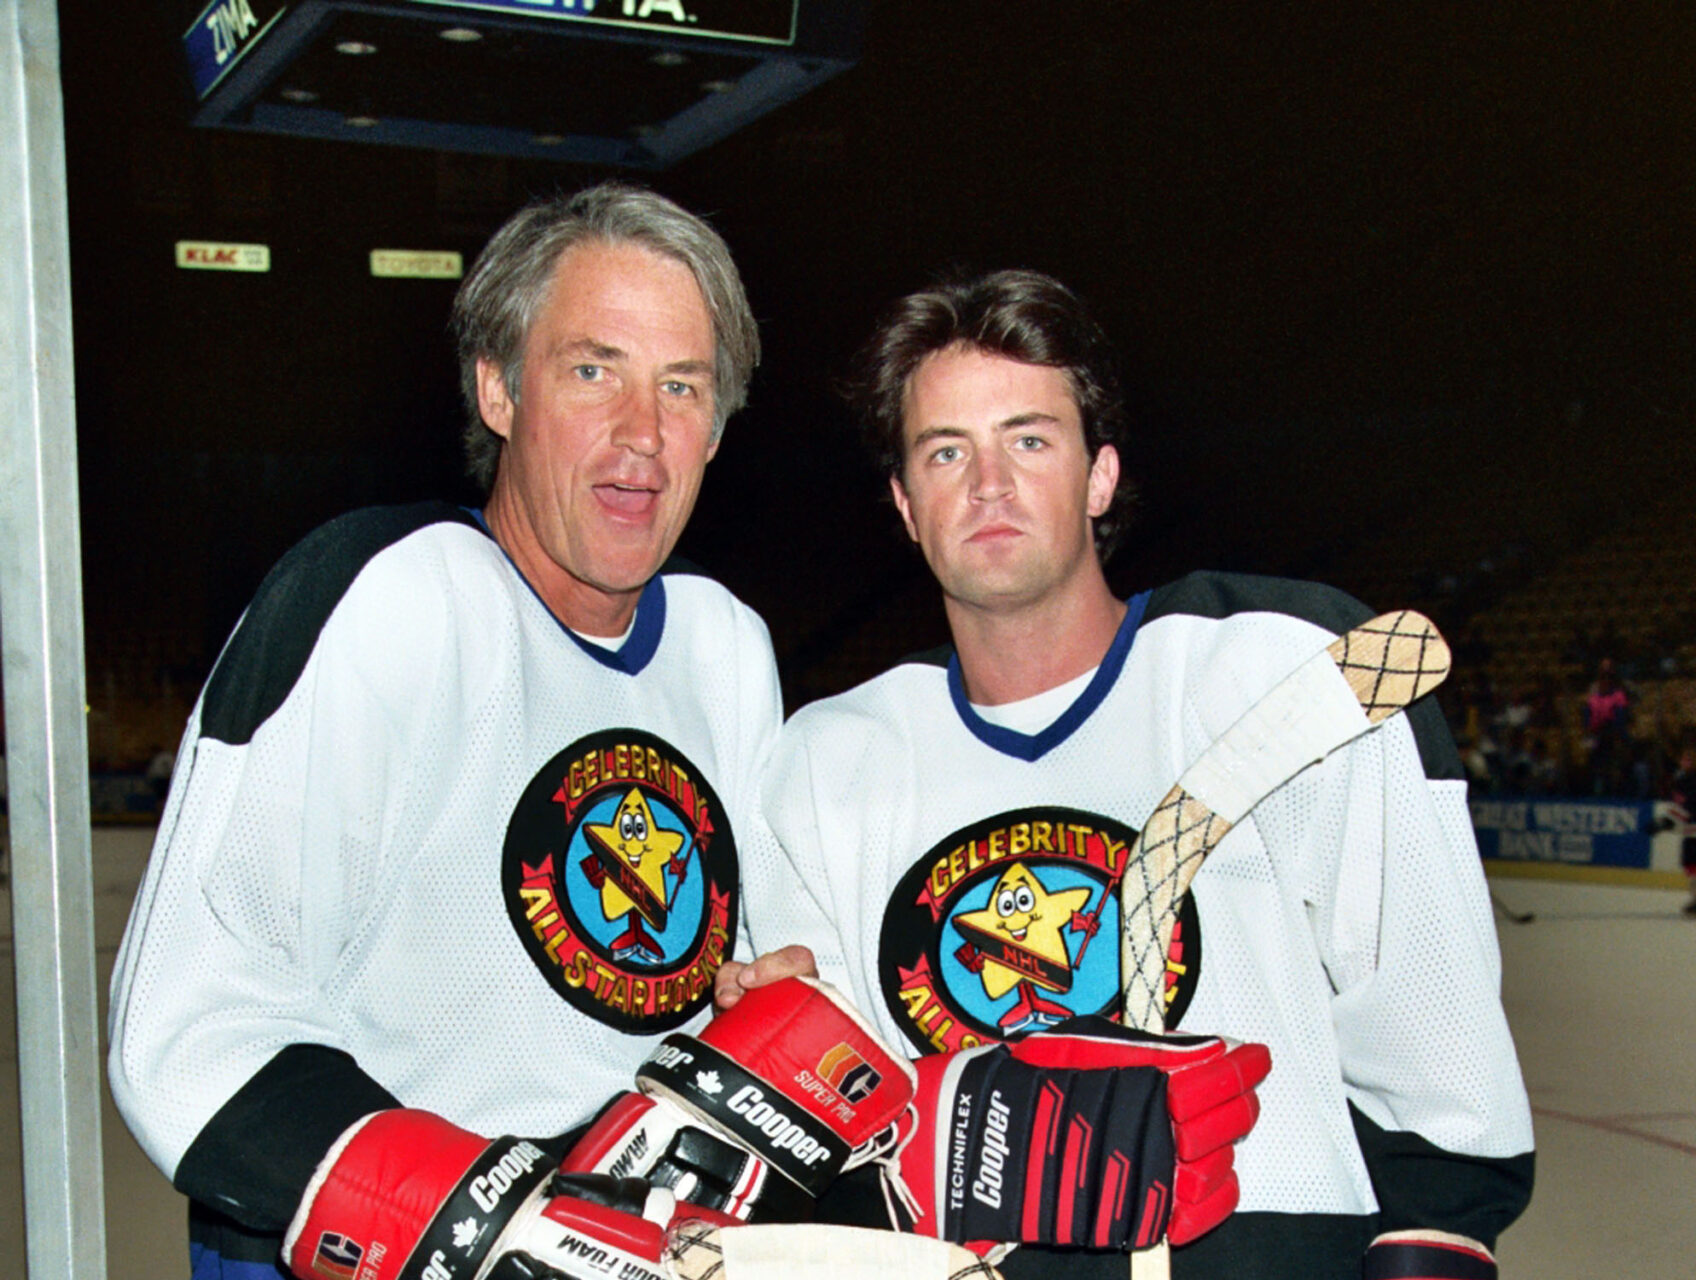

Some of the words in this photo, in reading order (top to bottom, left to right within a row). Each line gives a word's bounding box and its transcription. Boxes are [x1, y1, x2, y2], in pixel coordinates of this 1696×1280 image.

[206, 0, 259, 66] ZIMA
[185, 248, 238, 265] KLAC
[378, 256, 456, 273] TOYOTA
[568, 744, 708, 823] CELEBRITY
[930, 820, 1125, 897] CELEBRITY
[519, 888, 569, 965] ALL
[563, 949, 646, 1019] STAR
[652, 911, 730, 1016] HOCKEY
[1003, 945, 1049, 978] NHL
[899, 985, 955, 1053] ALL
[794, 1069, 837, 1107] SUPER
[608, 1126, 649, 1181] ARMO
[726, 1084, 831, 1166] Cooper
[951, 1093, 973, 1210] TECHNIFLEX
[972, 1090, 1011, 1210] Cooper
[558, 1233, 622, 1271] FOAM
